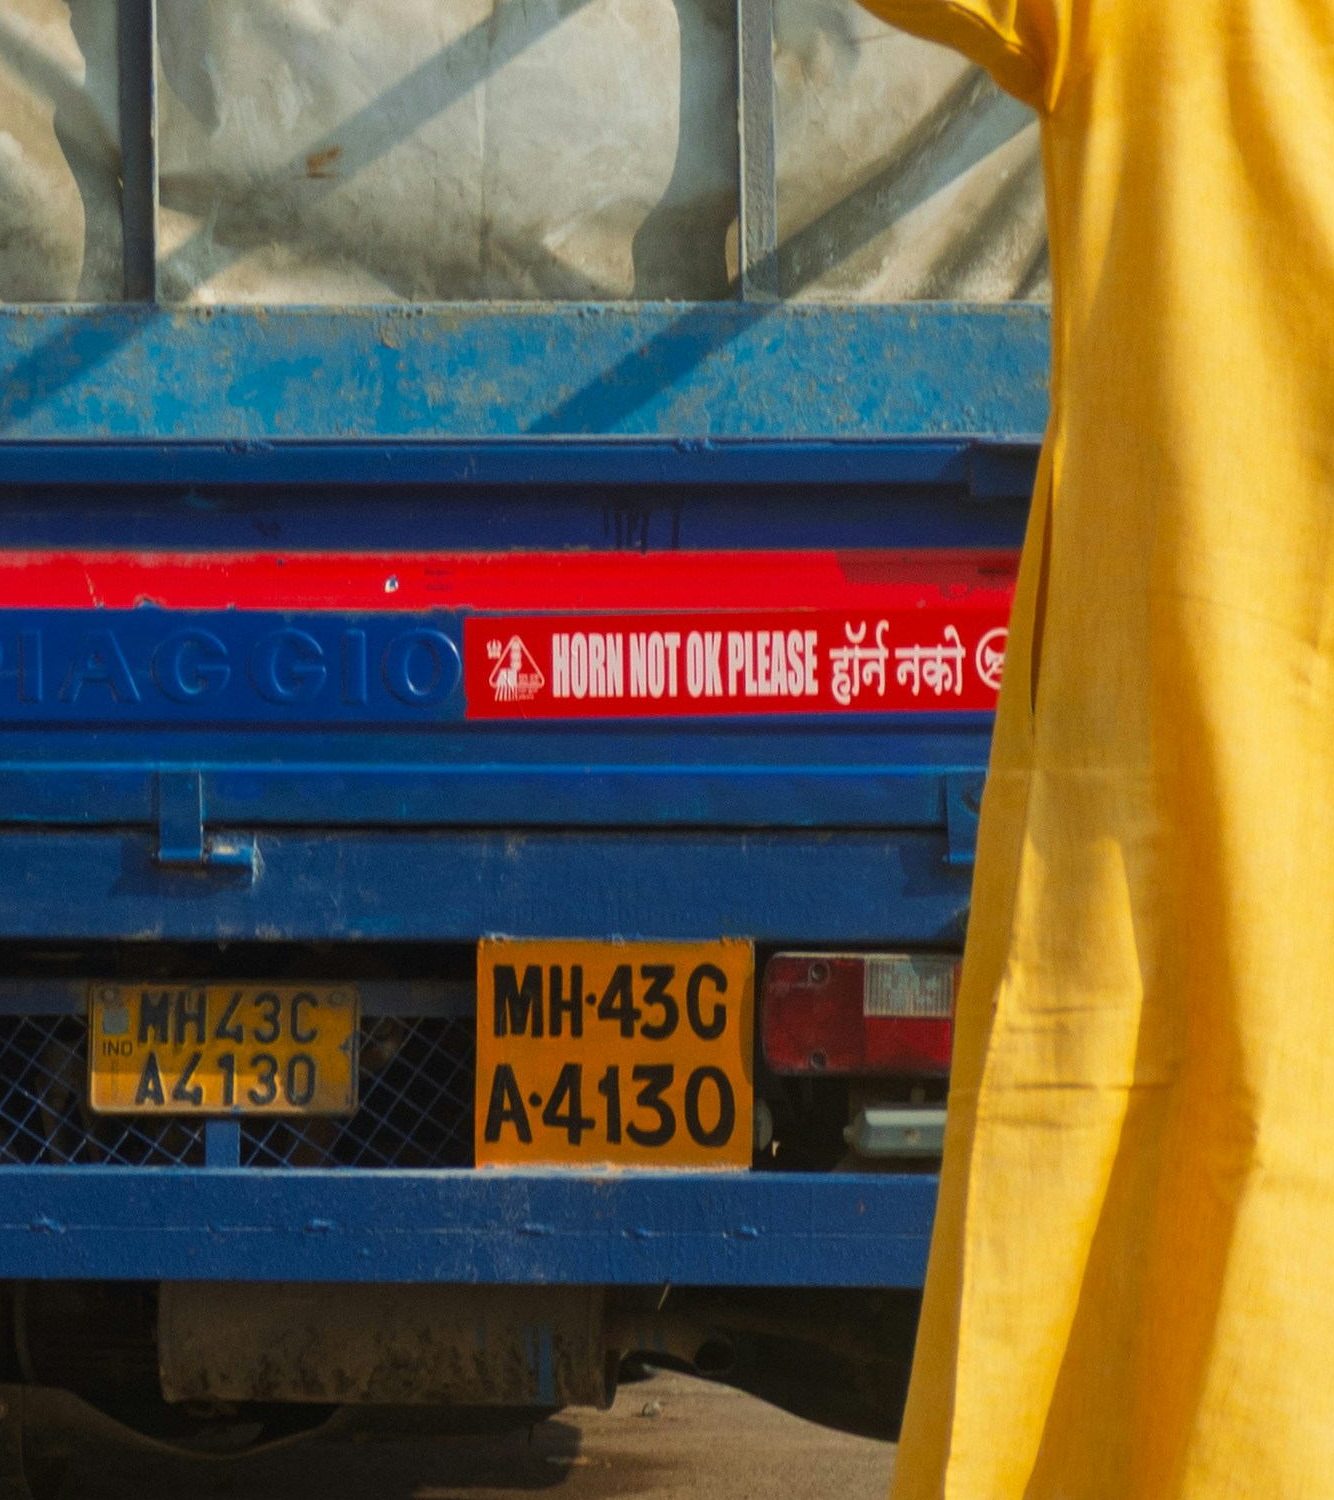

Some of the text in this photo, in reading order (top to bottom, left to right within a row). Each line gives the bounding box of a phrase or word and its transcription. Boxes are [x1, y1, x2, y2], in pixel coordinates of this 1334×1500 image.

[552, 632, 625, 699] HORN
[628, 631, 682, 698] NOT
[685, 631, 723, 698] OK
[727, 630, 819, 698] PLEASE
[828, 619, 967, 706] हॉर्न नको
[137, 990, 319, 1046] MH43C
[101, 1040, 134, 1057] IND
[134, 1050, 317, 1107] A4130
